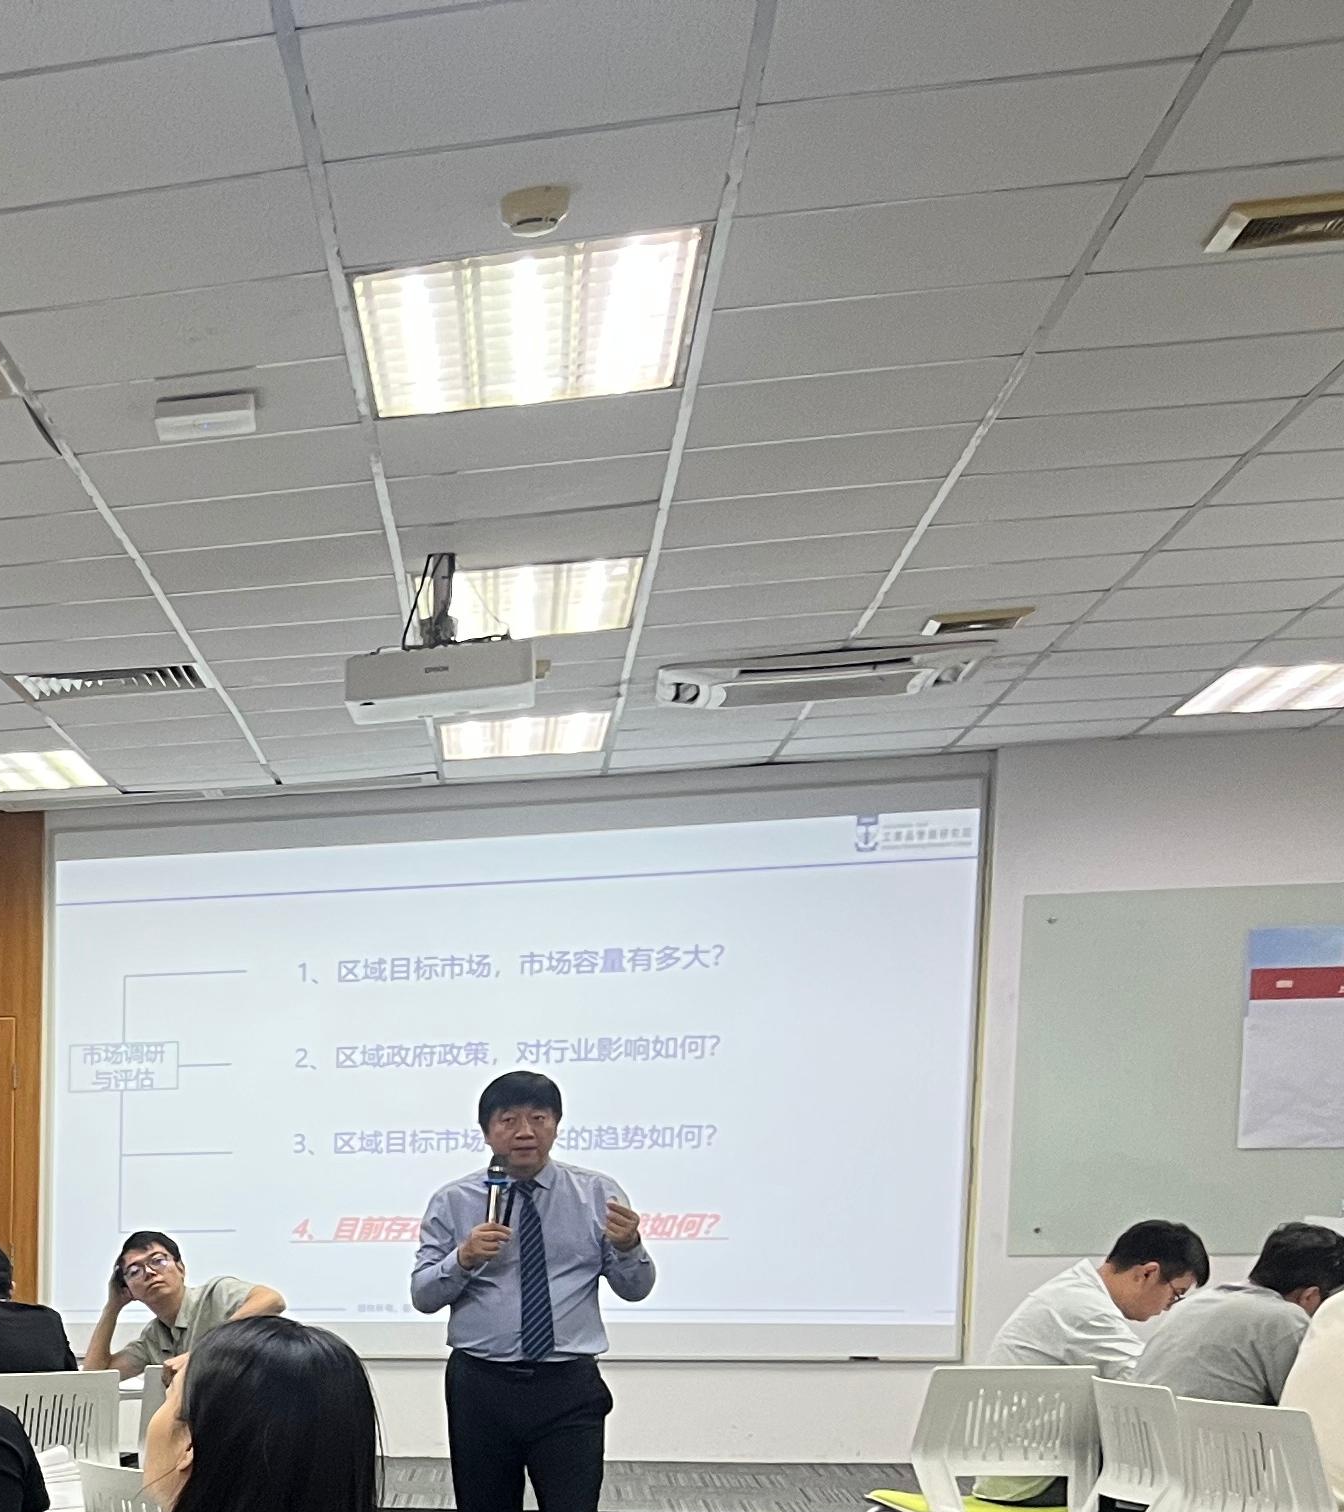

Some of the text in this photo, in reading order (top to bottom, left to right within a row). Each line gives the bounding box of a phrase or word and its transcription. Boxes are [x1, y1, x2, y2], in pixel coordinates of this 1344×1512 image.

[82, 1043, 166, 1065] 市场调研
[92, 1068, 155, 1090] 与评估
